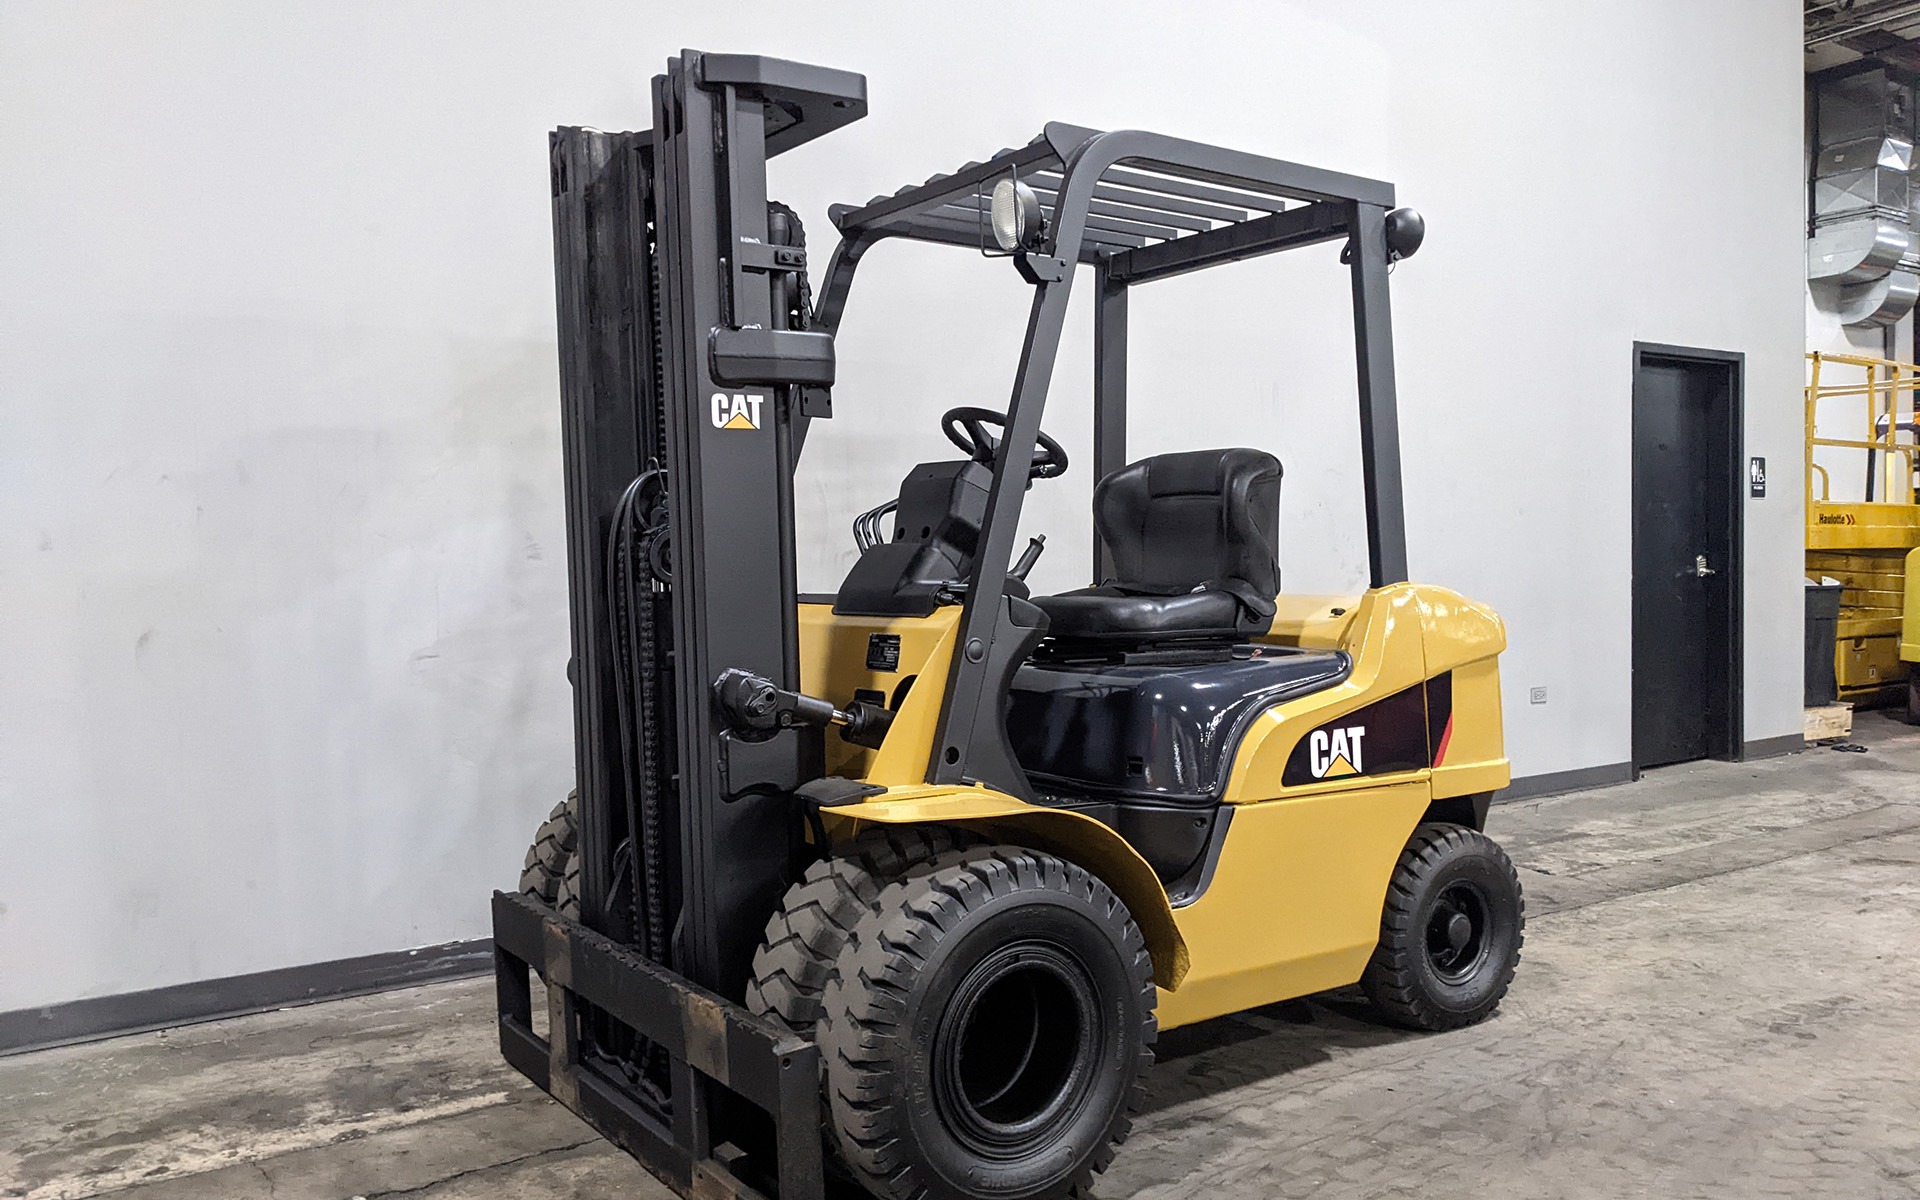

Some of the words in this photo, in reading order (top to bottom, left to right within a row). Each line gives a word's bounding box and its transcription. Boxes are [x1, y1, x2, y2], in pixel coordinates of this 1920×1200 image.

[711, 393, 763, 429] CAT
[1819, 513, 1845, 524] Haulotte
[1310, 726, 1365, 778] CAT
